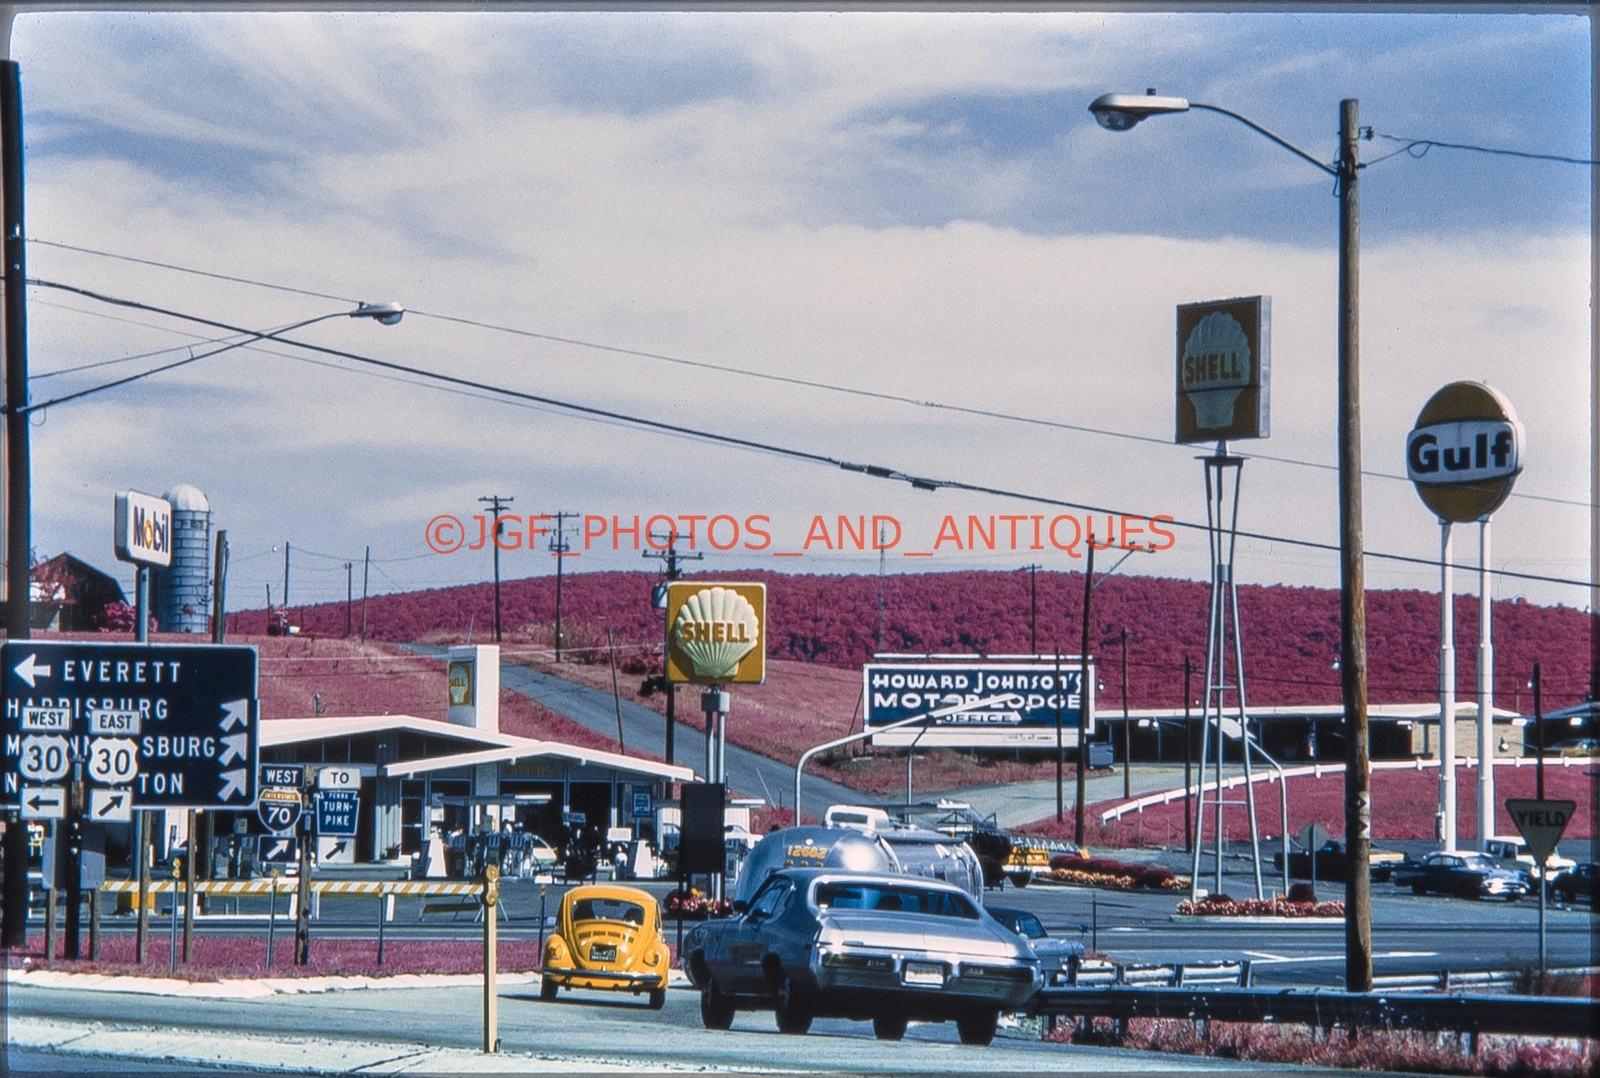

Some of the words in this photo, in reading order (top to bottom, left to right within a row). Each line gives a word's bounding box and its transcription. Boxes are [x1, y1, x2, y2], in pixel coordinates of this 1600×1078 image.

[1185, 352, 1242, 383] SHELL
[1409, 431, 1512, 474] Gulf
[133, 505, 168, 553] Mobil
[682, 621, 750, 643] SHELL
[63, 660, 181, 684] EVERETT
[872, 674, 969, 689] HOWARD
[990, 694, 1081, 709] LODGE
[29, 711, 64, 726] WEST
[100, 714, 132, 729] EAST
[945, 714, 1012, 723] OFFICE
[27, 745, 61, 773] 30
[96, 748, 130, 775] 30
[266, 769, 299, 784] WEST
[331, 772, 349, 784] TO
[268, 807, 290, 824] 70
[325, 815, 350, 827] PIKE
[1517, 810, 1566, 827] YIELD
